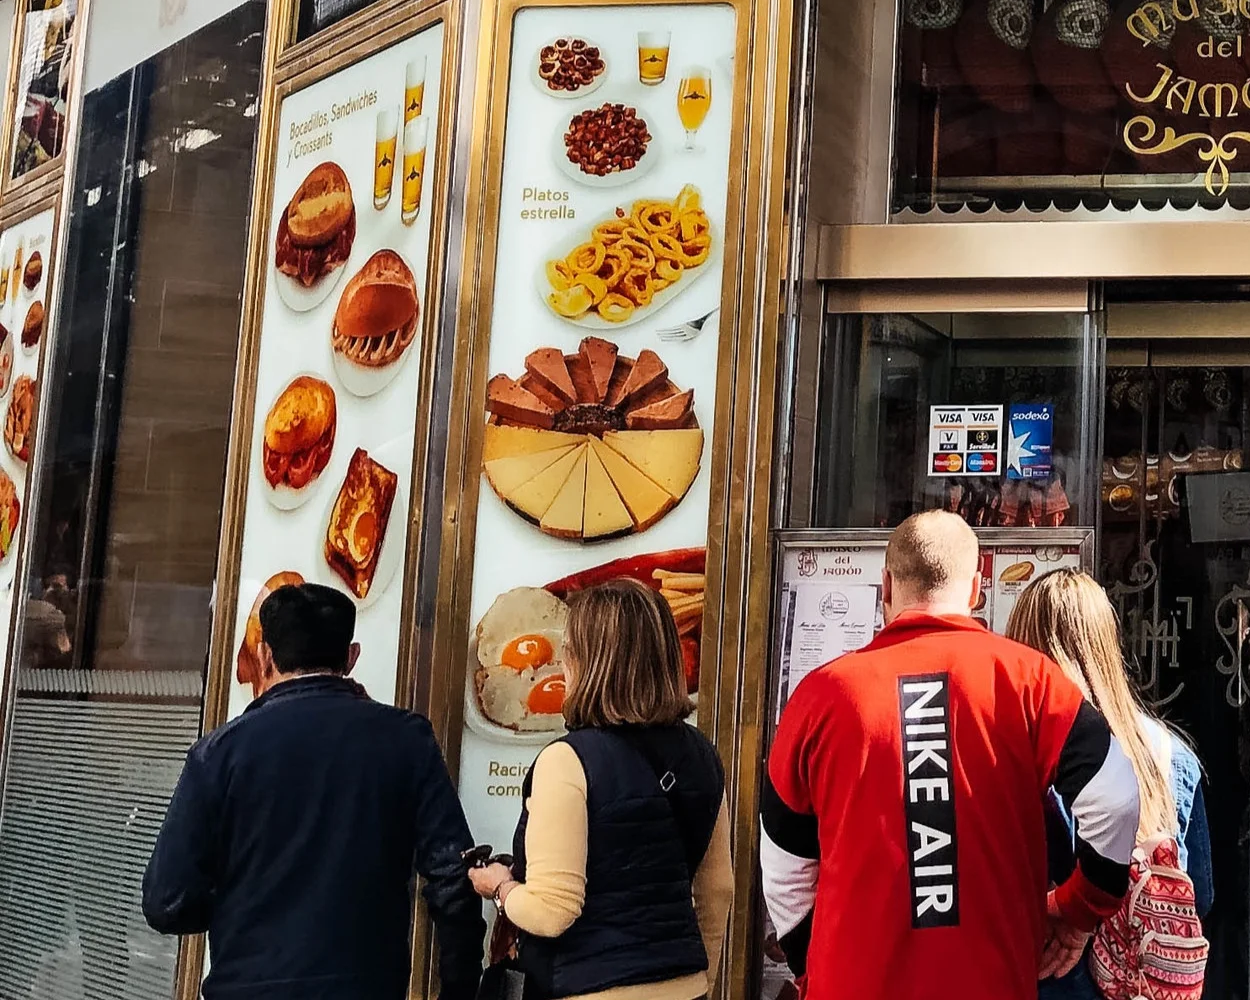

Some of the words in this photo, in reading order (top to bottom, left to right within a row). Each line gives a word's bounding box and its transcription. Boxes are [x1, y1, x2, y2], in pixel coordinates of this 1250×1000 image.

[1196, 35, 1242, 58] del
[330, 90, 378, 122] Sandwiches
[293, 131, 333, 159] Croissants
[522, 187, 570, 202] Platos
[520, 205, 576, 220] estrella
[939, 413, 962, 423] VISA
[972, 412, 995, 422] VISA
[1012, 407, 1050, 421] sodexo
[944, 432, 953, 442] V
[903, 680, 950, 803] NIKE
[488, 761, 530, 777] Racio
[487, 784, 521, 796] com
[911, 821, 953, 918] AIR
